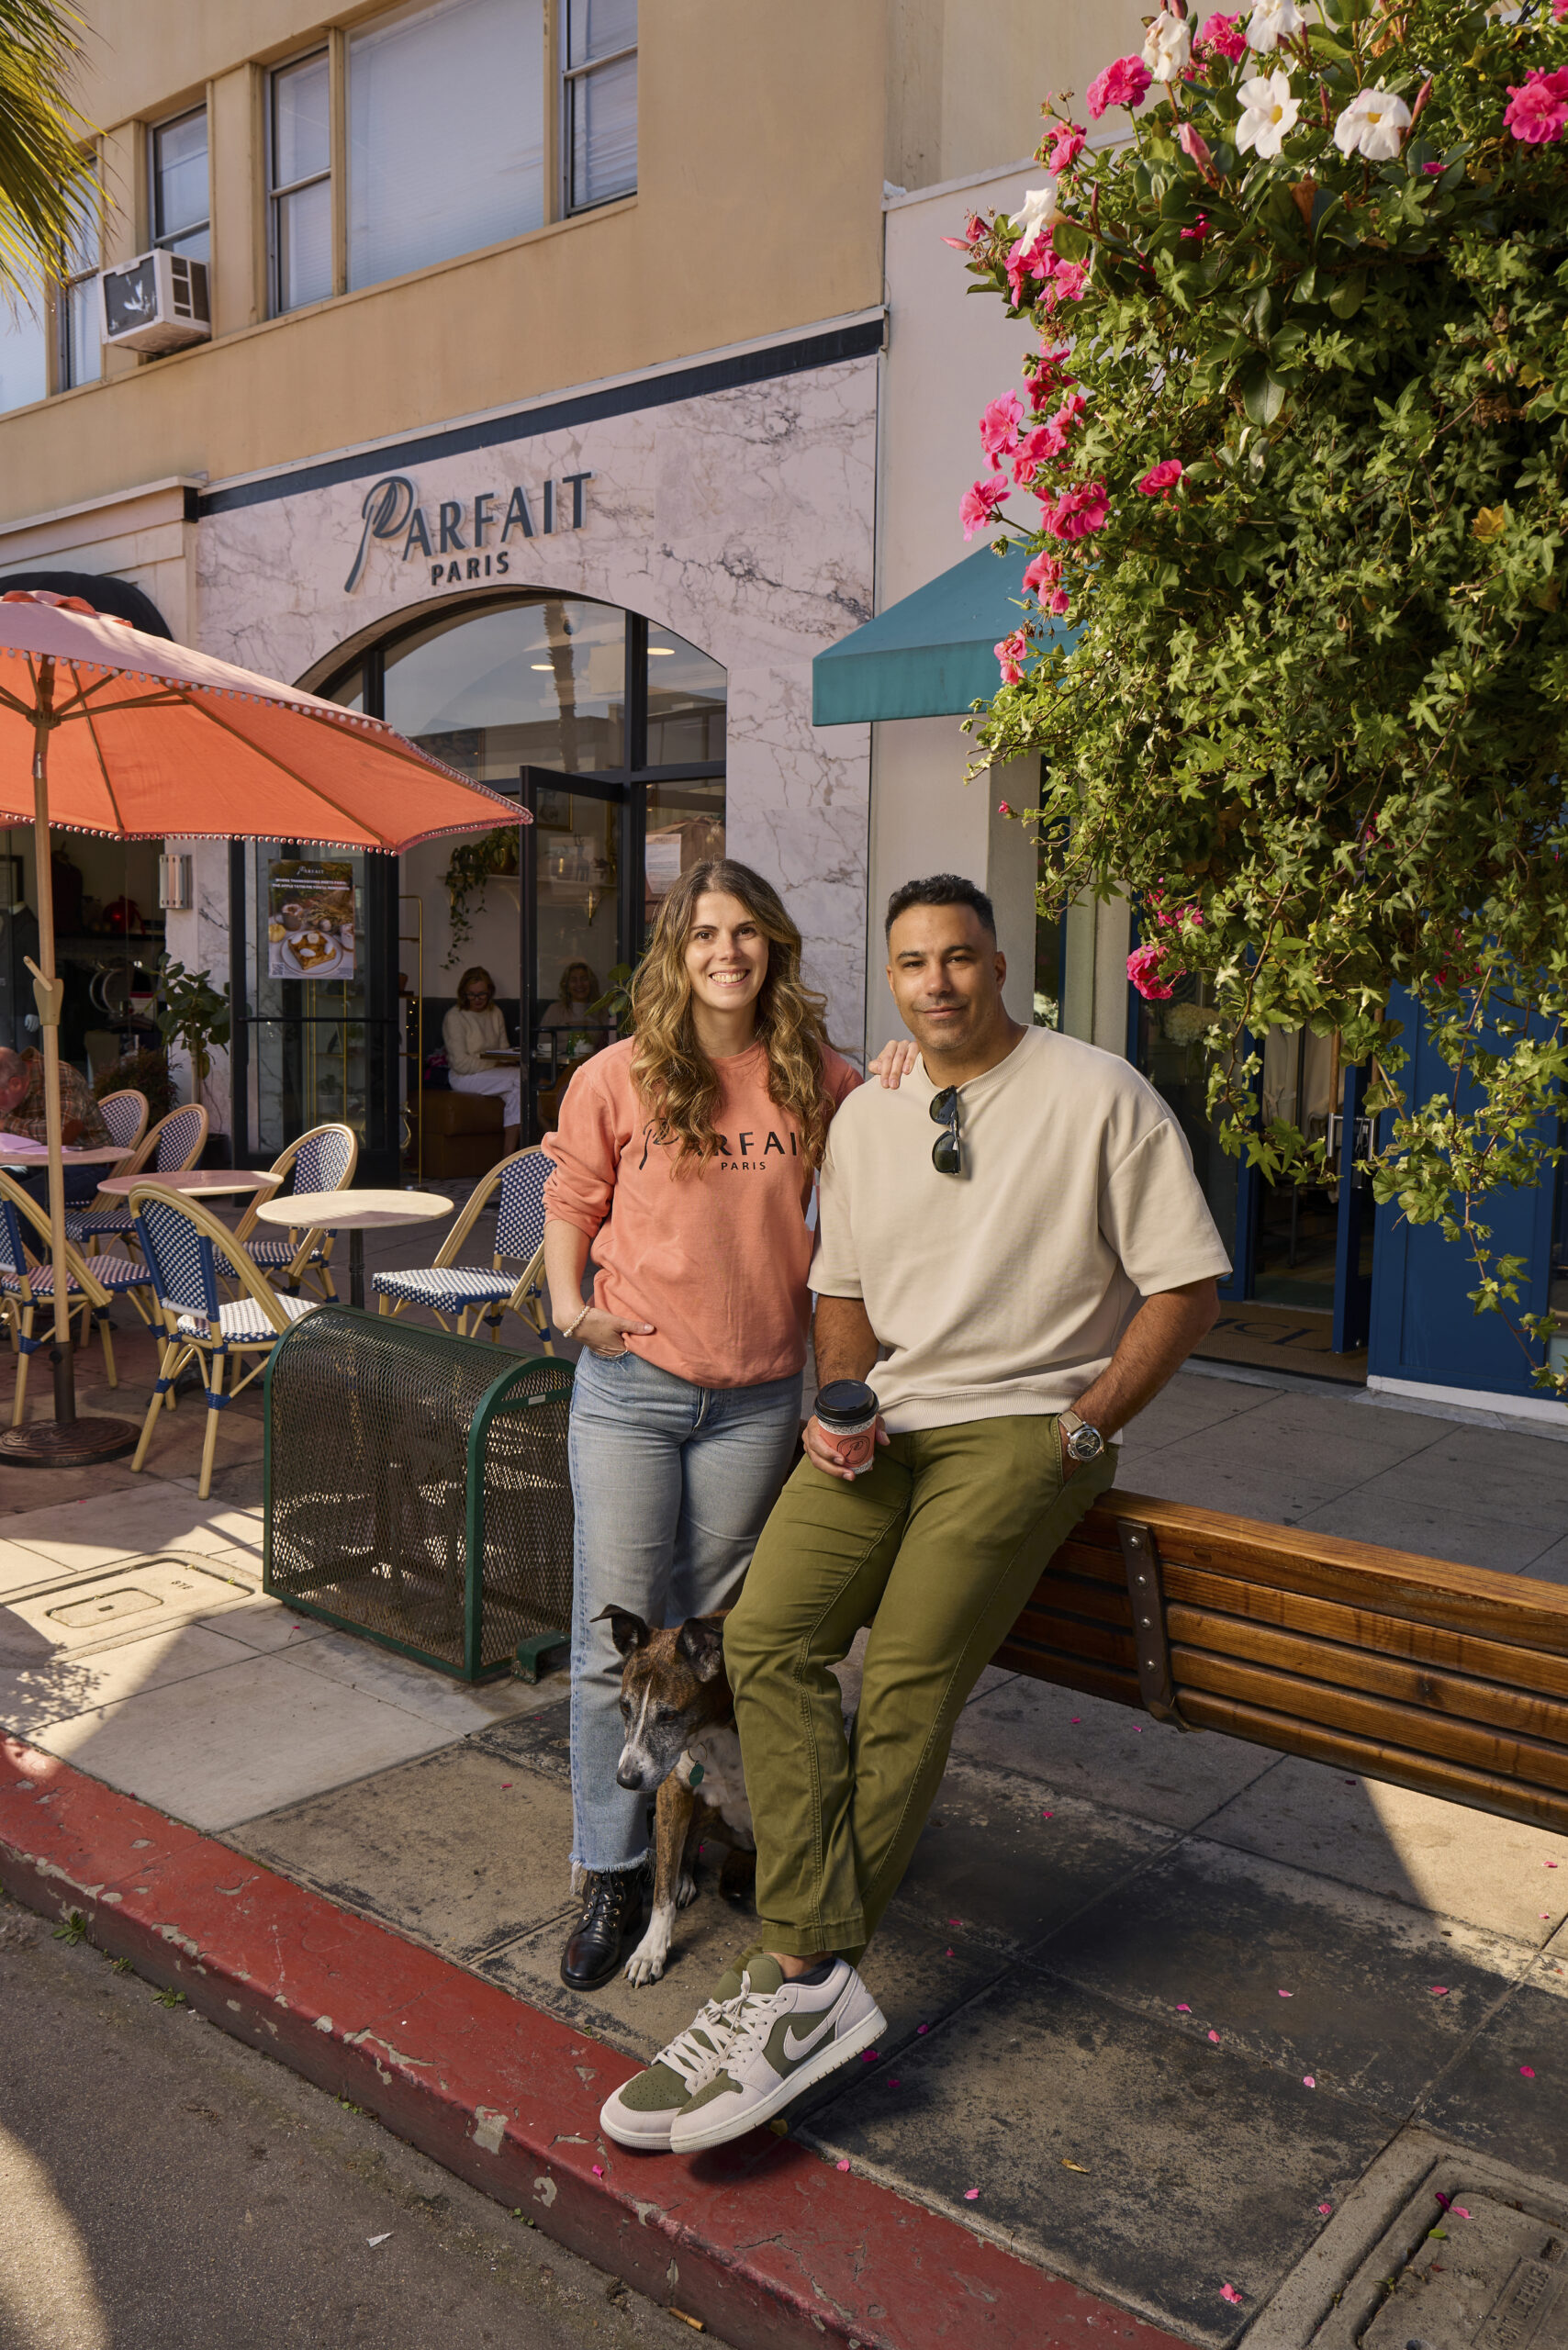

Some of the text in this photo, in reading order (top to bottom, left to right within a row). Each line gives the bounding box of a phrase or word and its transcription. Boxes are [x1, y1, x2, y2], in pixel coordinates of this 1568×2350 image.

[344, 472, 596, 594] PARFAIT
[431, 551, 510, 586] PARIS
[721, 1161, 766, 1170] PARIS
